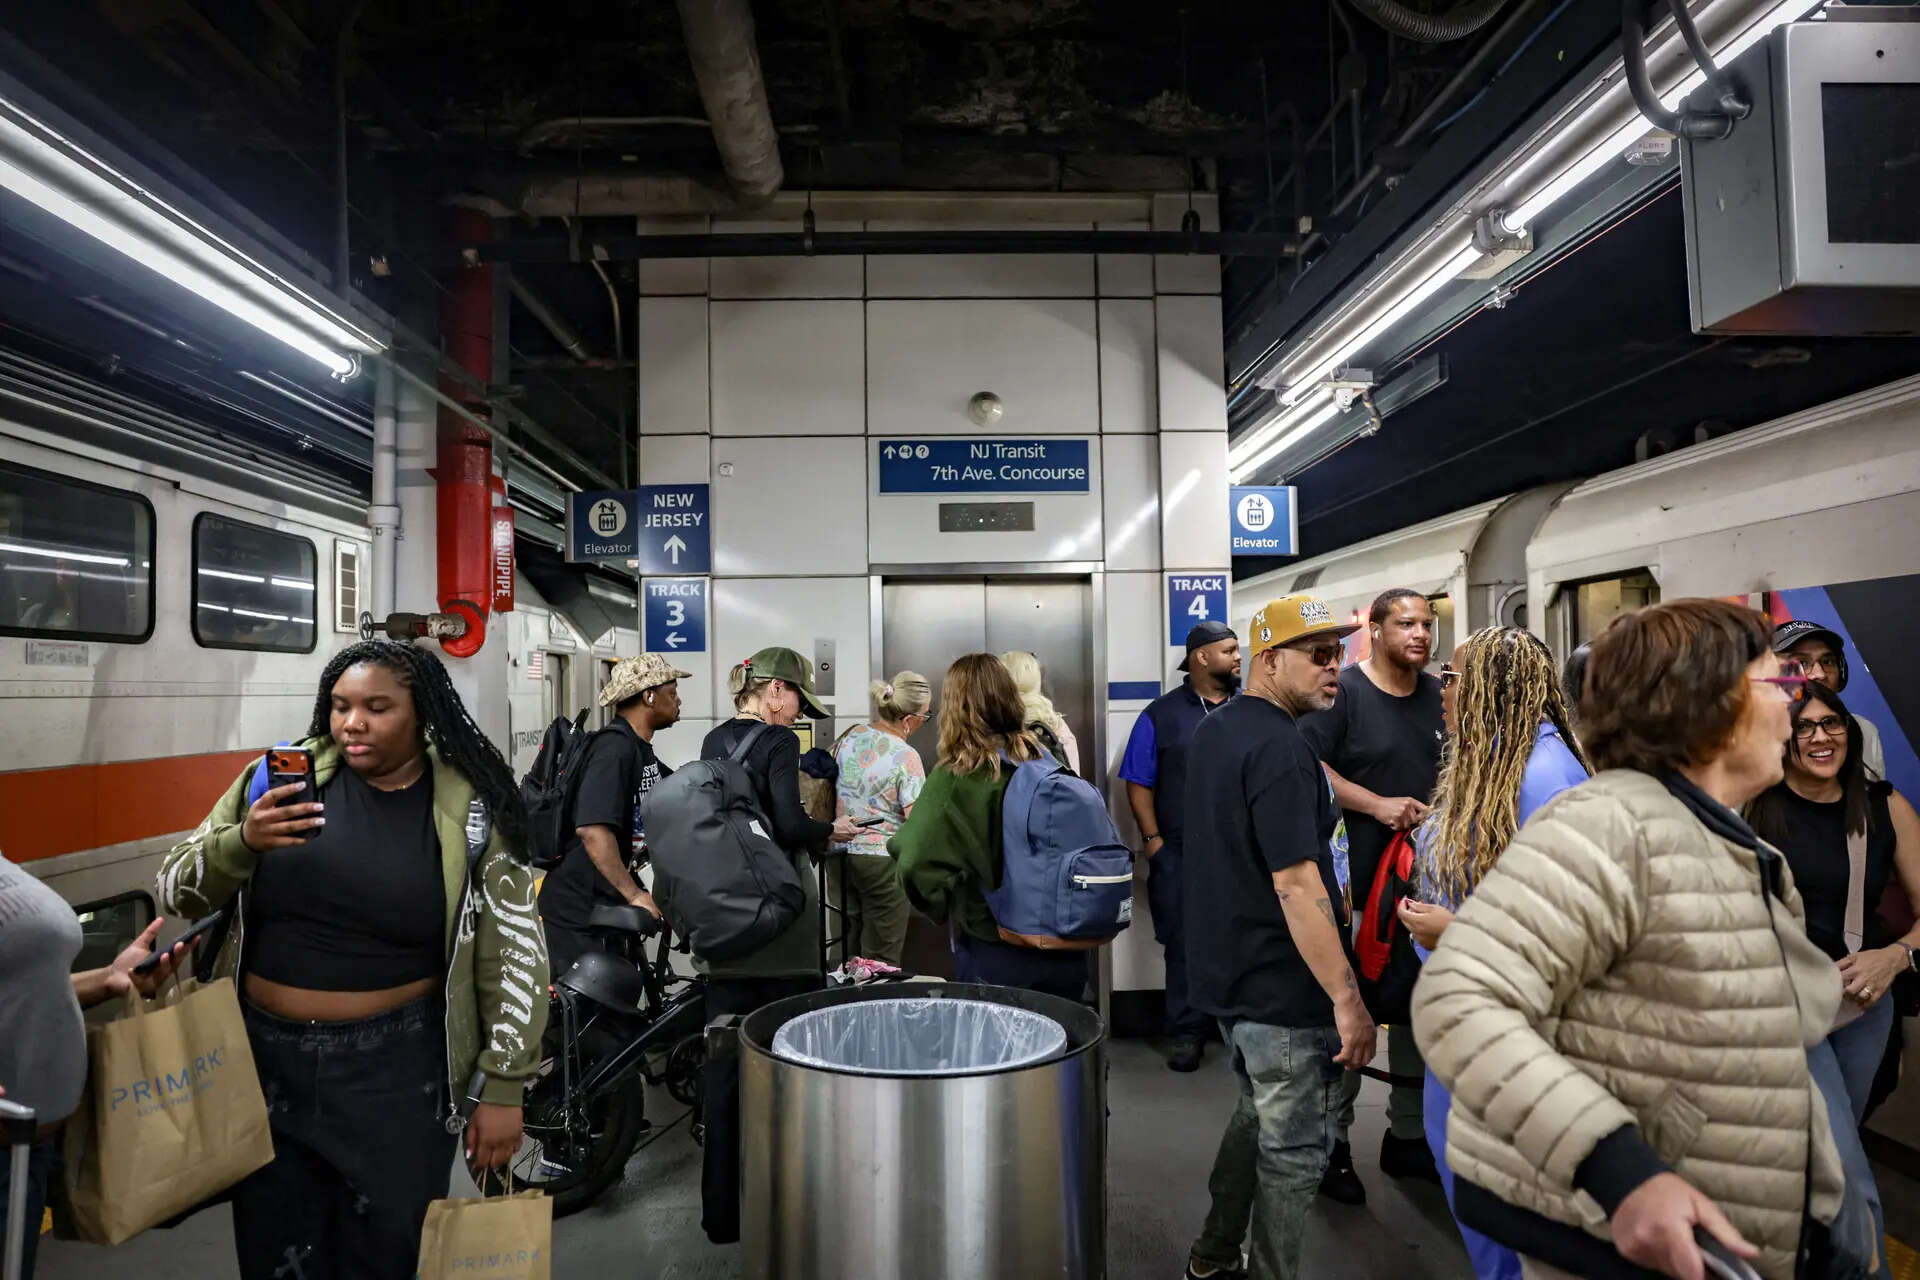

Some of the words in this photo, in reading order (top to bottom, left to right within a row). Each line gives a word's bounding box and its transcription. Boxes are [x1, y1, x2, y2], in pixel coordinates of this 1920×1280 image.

[970, 444, 990, 459] NJ
[992, 443, 1046, 459] Transit
[930, 465, 959, 480] 7th
[961, 465, 996, 480] Ave.
[1000, 465, 1086, 480] Concourse
[653, 493, 695, 508] NEW
[645, 512, 704, 528] JERSEY
[584, 543, 632, 555] Elevator
[1233, 537, 1279, 548] Elevator
[496, 520, 511, 598] STANDPIPE
[649, 583, 701, 597] TRACK
[1173, 578, 1223, 591] TRACK
[665, 600, 685, 627] 3
[1187, 594, 1210, 620] 4
